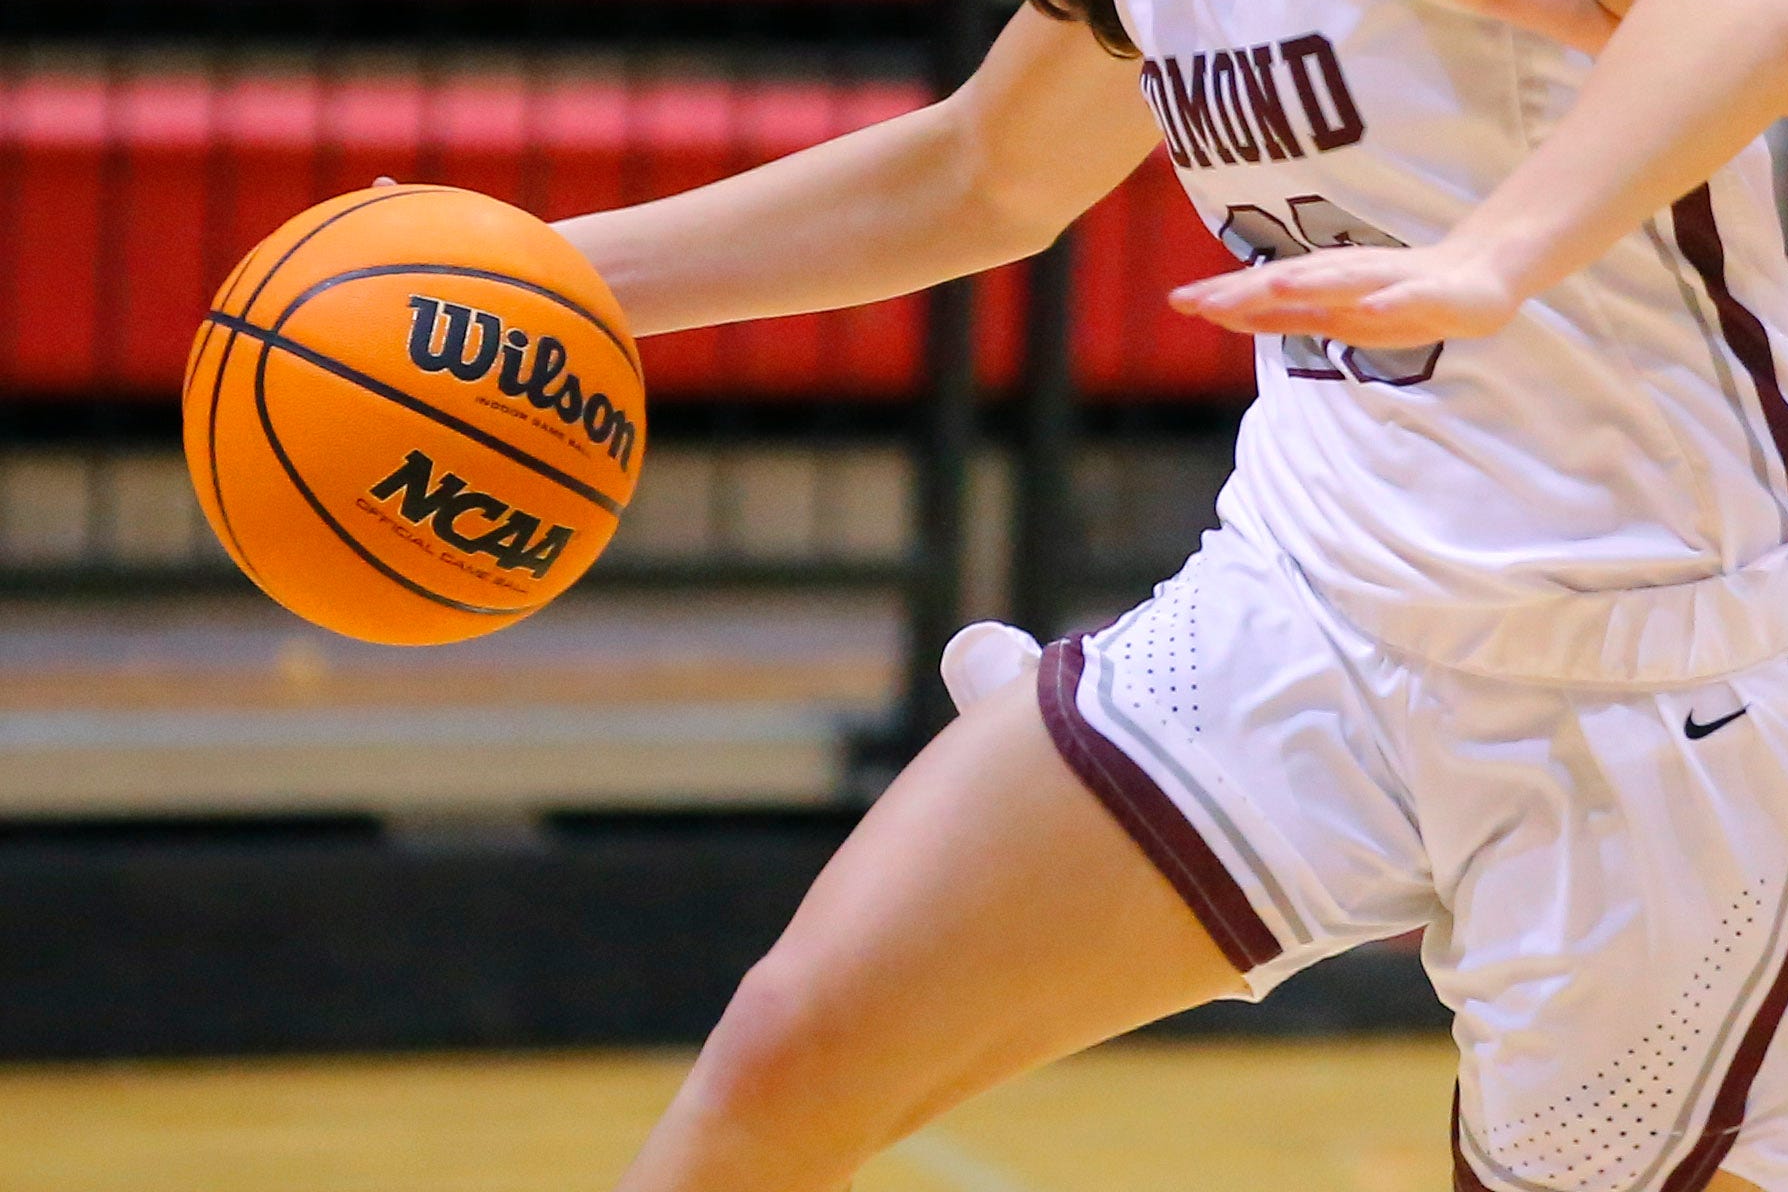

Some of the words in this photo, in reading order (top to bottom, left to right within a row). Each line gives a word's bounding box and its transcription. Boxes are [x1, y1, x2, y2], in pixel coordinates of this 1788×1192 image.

[1141, 32, 1367, 169] DMOND
[408, 294, 637, 474] Wilson
[355, 496, 435, 557] OFFICIAL
[368, 446, 577, 581] NCAA
